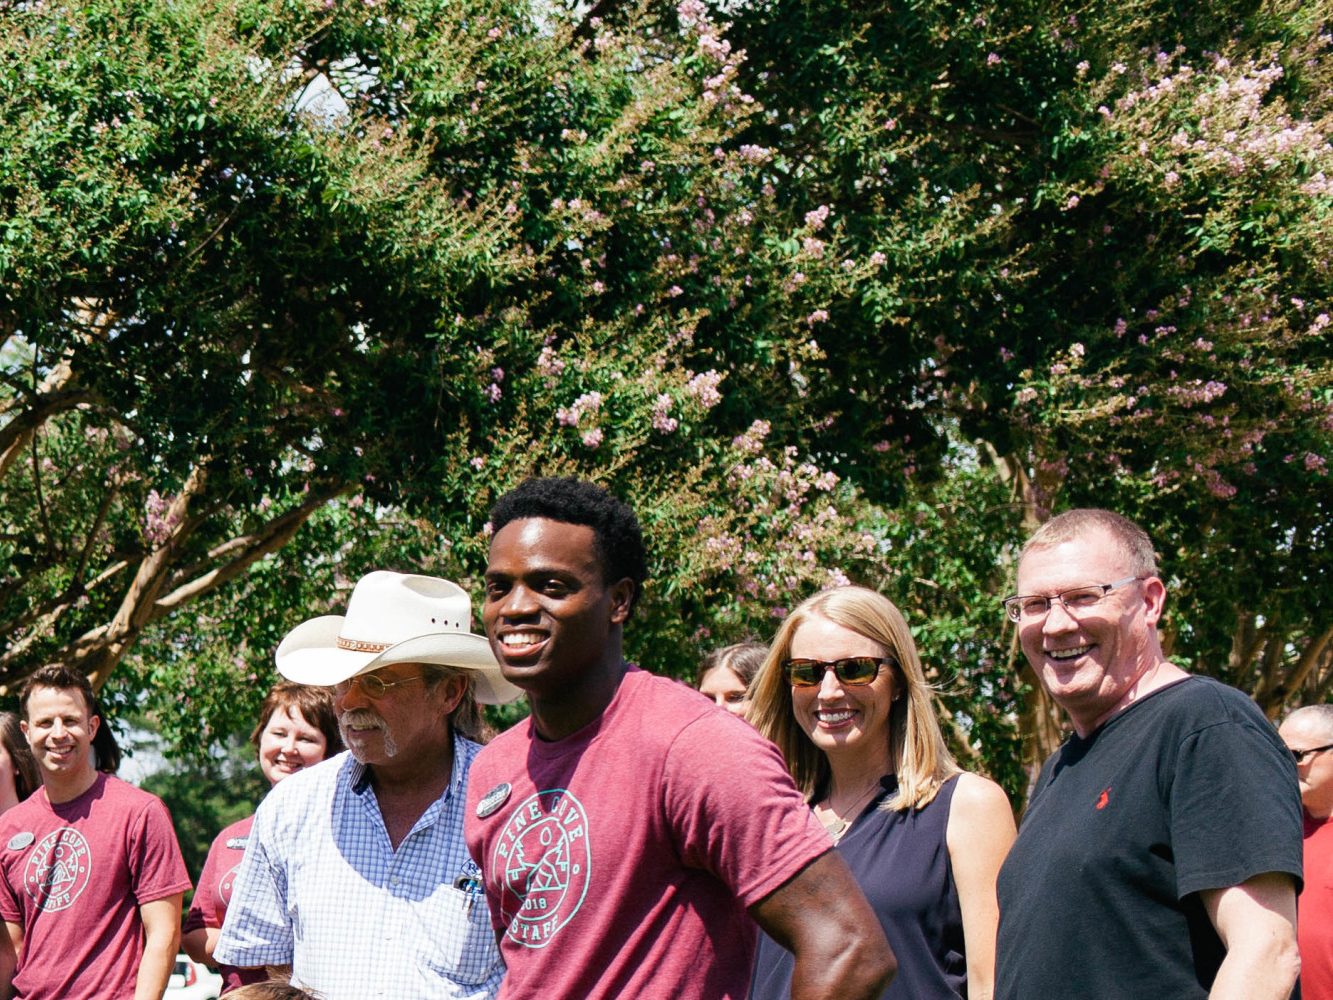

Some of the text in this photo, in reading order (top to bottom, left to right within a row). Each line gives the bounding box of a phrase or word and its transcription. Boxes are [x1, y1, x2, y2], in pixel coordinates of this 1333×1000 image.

[499, 801, 542, 859] PINE
[551, 796, 583, 842] COVE
[62, 831, 86, 857] COVE
[512, 914, 558, 941] STAFF
